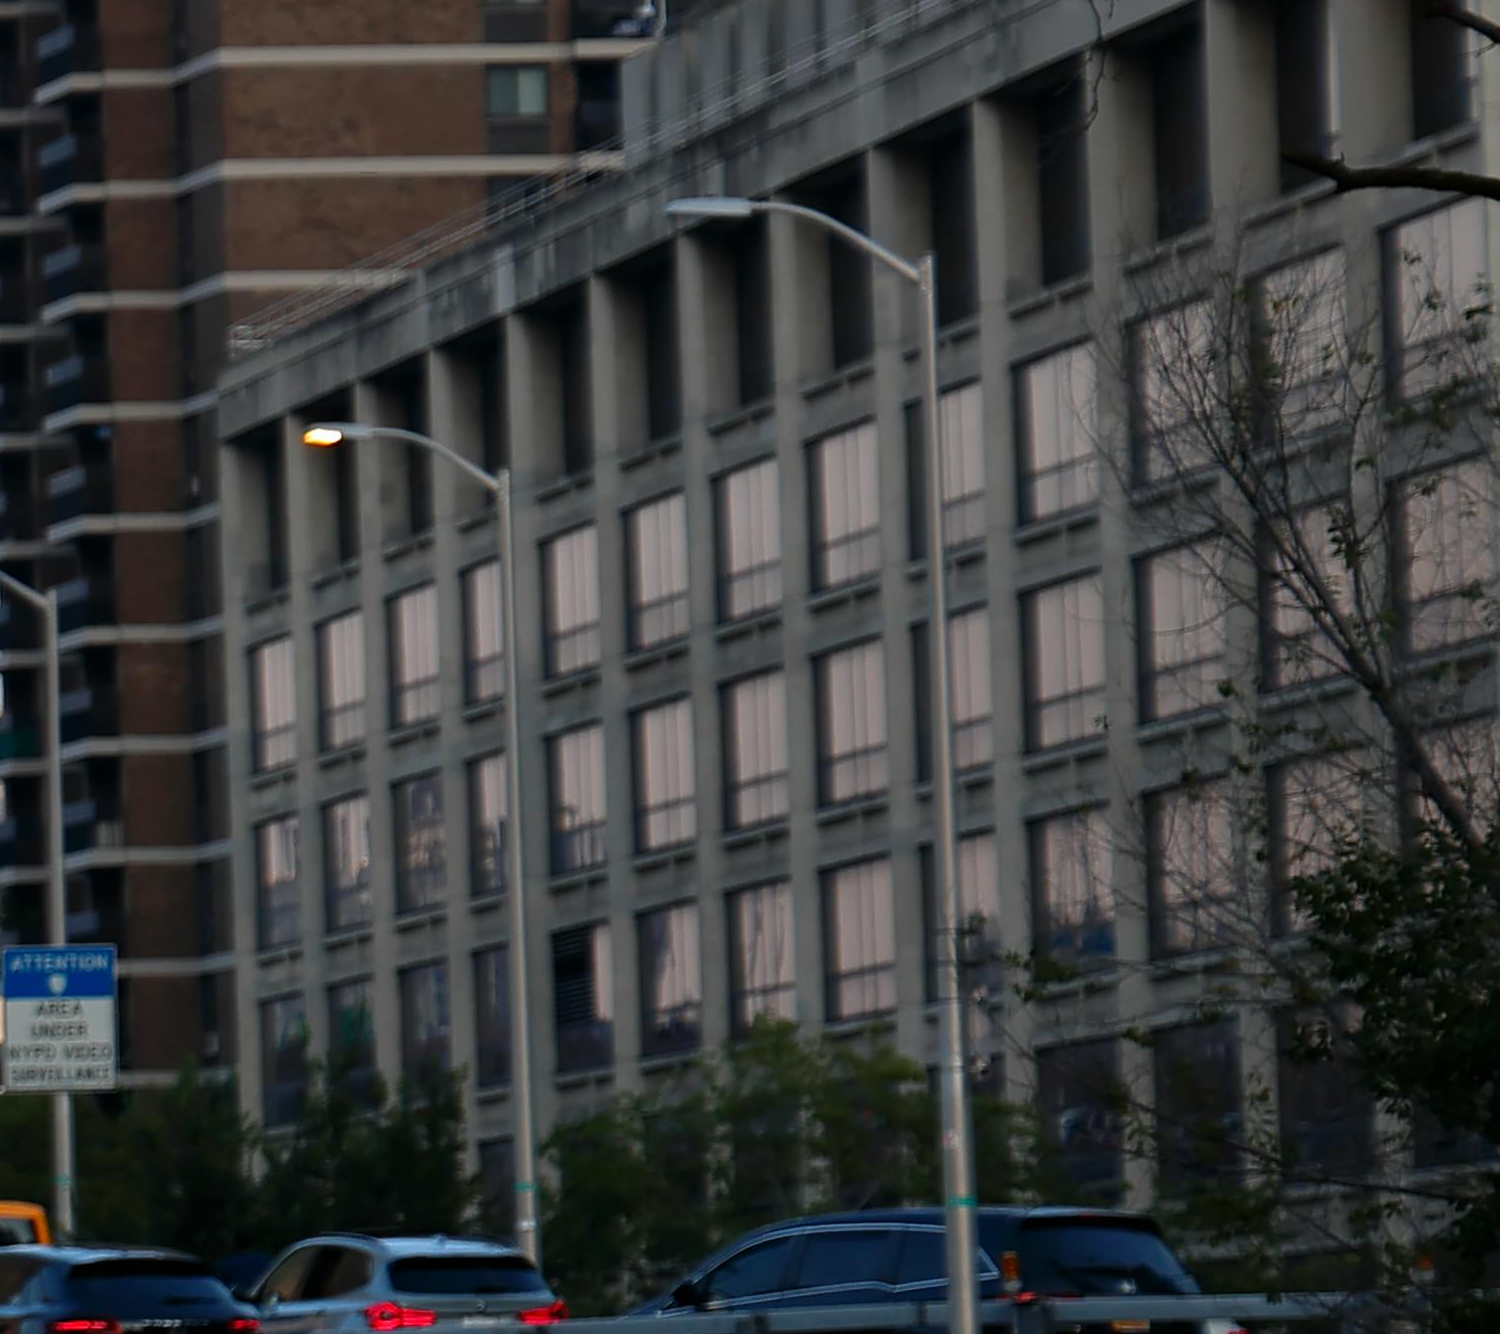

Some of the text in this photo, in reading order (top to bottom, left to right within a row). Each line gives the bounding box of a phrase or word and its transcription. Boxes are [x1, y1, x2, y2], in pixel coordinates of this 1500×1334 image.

[10, 953, 109, 971] ATTENTION
[36, 1000, 85, 1016] AREA
[30, 1021, 89, 1037] UNDER
[9, 1043, 113, 1061] NYPD VIDEO
[11, 1067, 111, 1082] SURVEILLANCE
